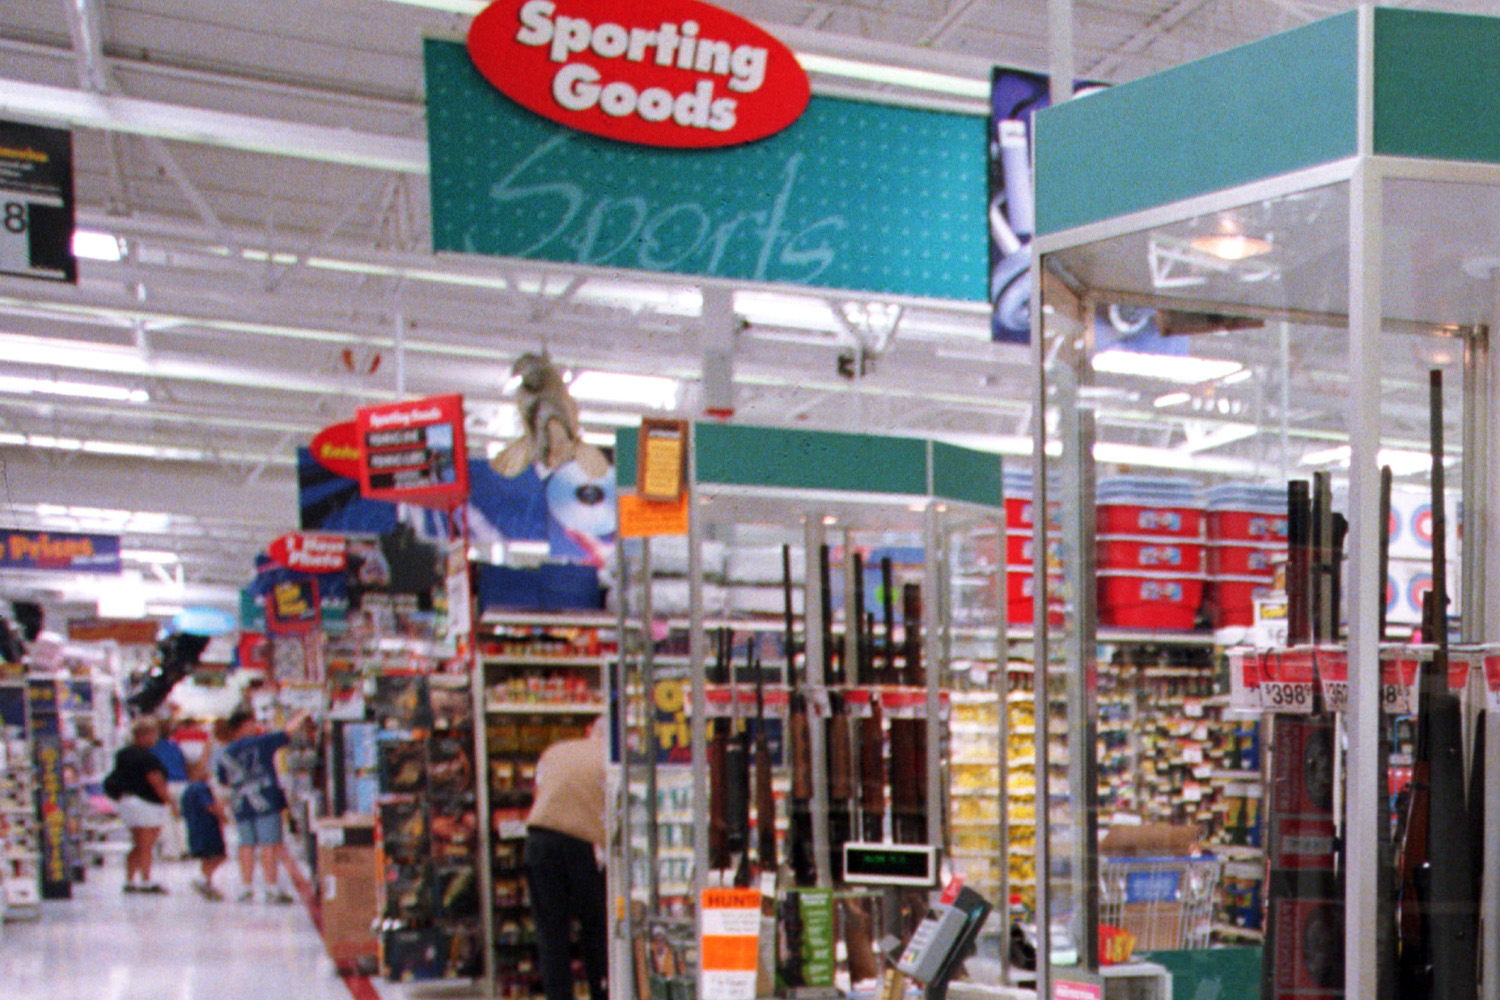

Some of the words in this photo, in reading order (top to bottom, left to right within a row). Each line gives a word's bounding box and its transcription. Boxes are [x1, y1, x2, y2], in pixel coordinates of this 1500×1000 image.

[517, 0, 768, 91] Sporting
[552, 60, 738, 132] Goods
[463, 133, 847, 283] Sports
